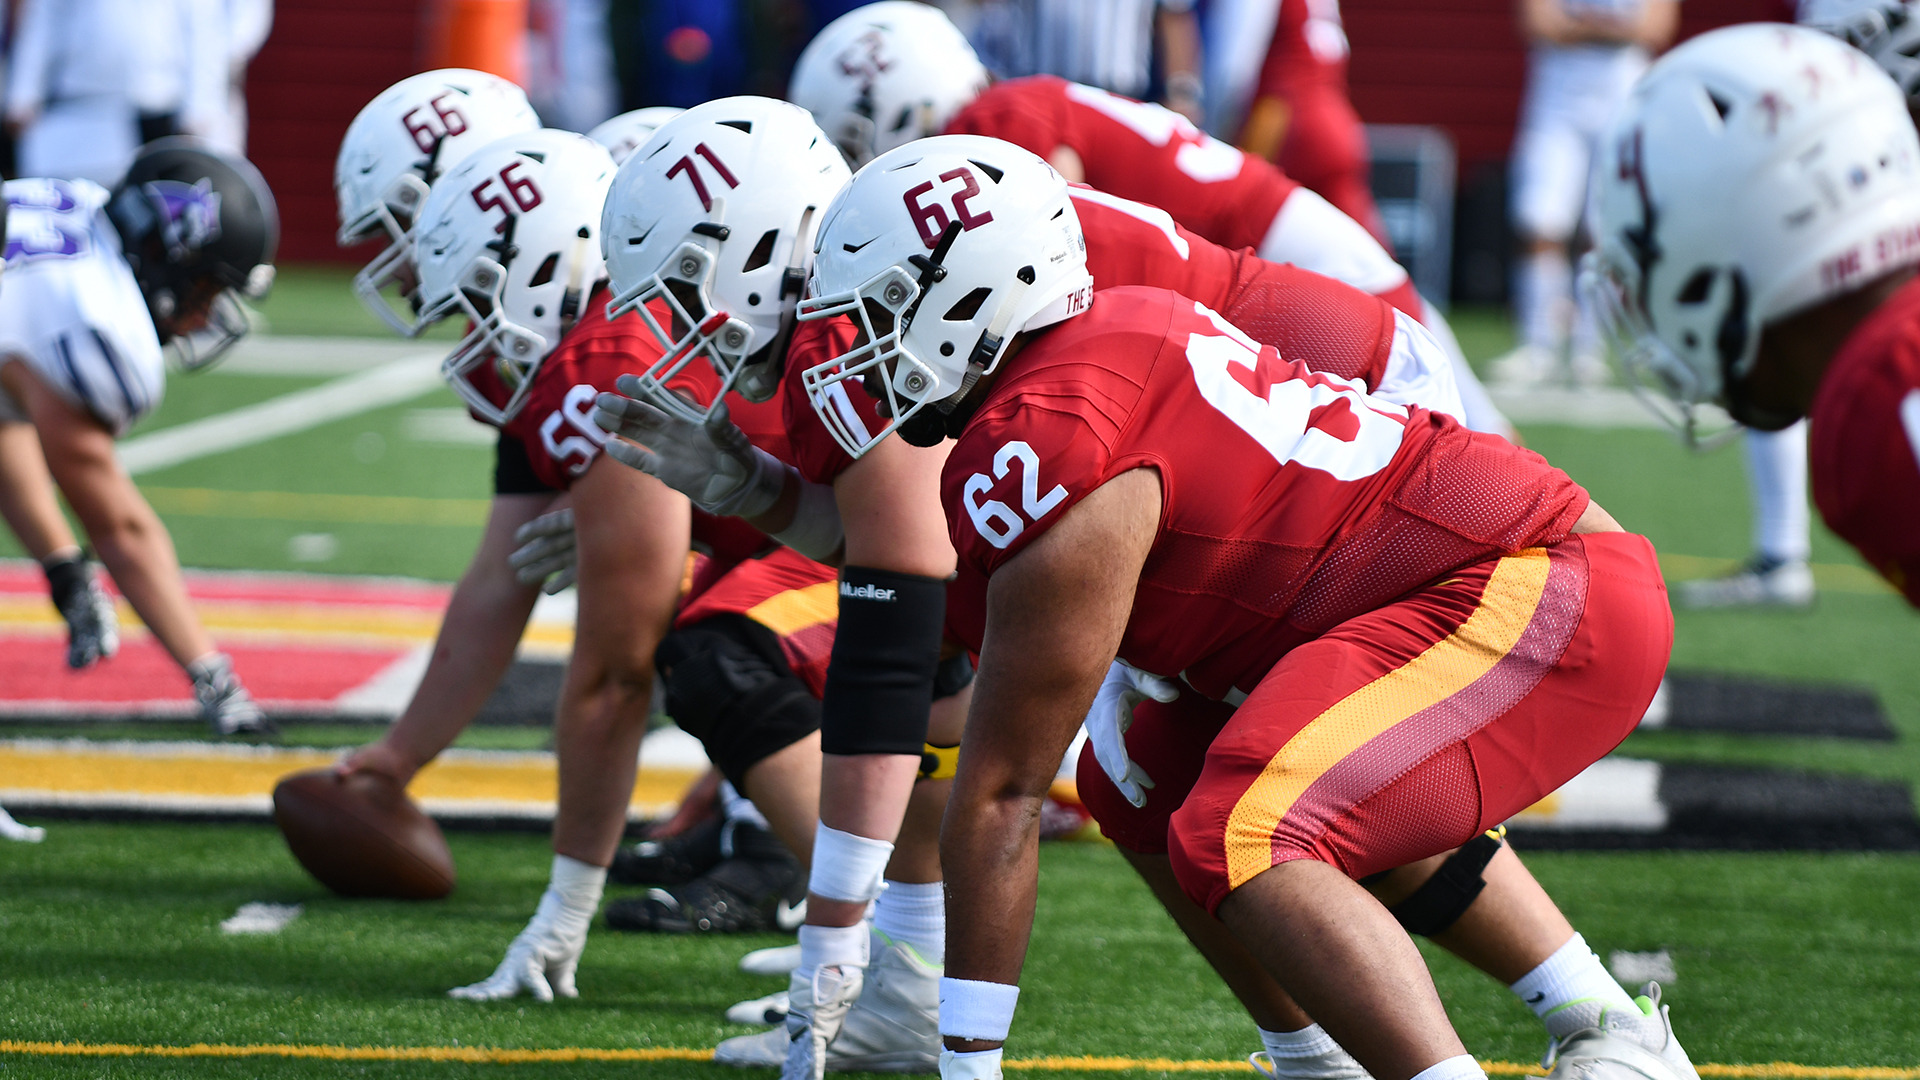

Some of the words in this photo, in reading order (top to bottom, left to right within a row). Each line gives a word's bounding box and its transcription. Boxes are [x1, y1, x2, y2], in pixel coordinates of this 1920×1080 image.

[403, 91, 467, 154] 66
[471, 161, 544, 235] 56
[664, 141, 741, 214] 71
[902, 166, 994, 250] 62
[1066, 287, 1085, 315] THE
[538, 384, 619, 474] 56
[963, 440, 1069, 549] 62
